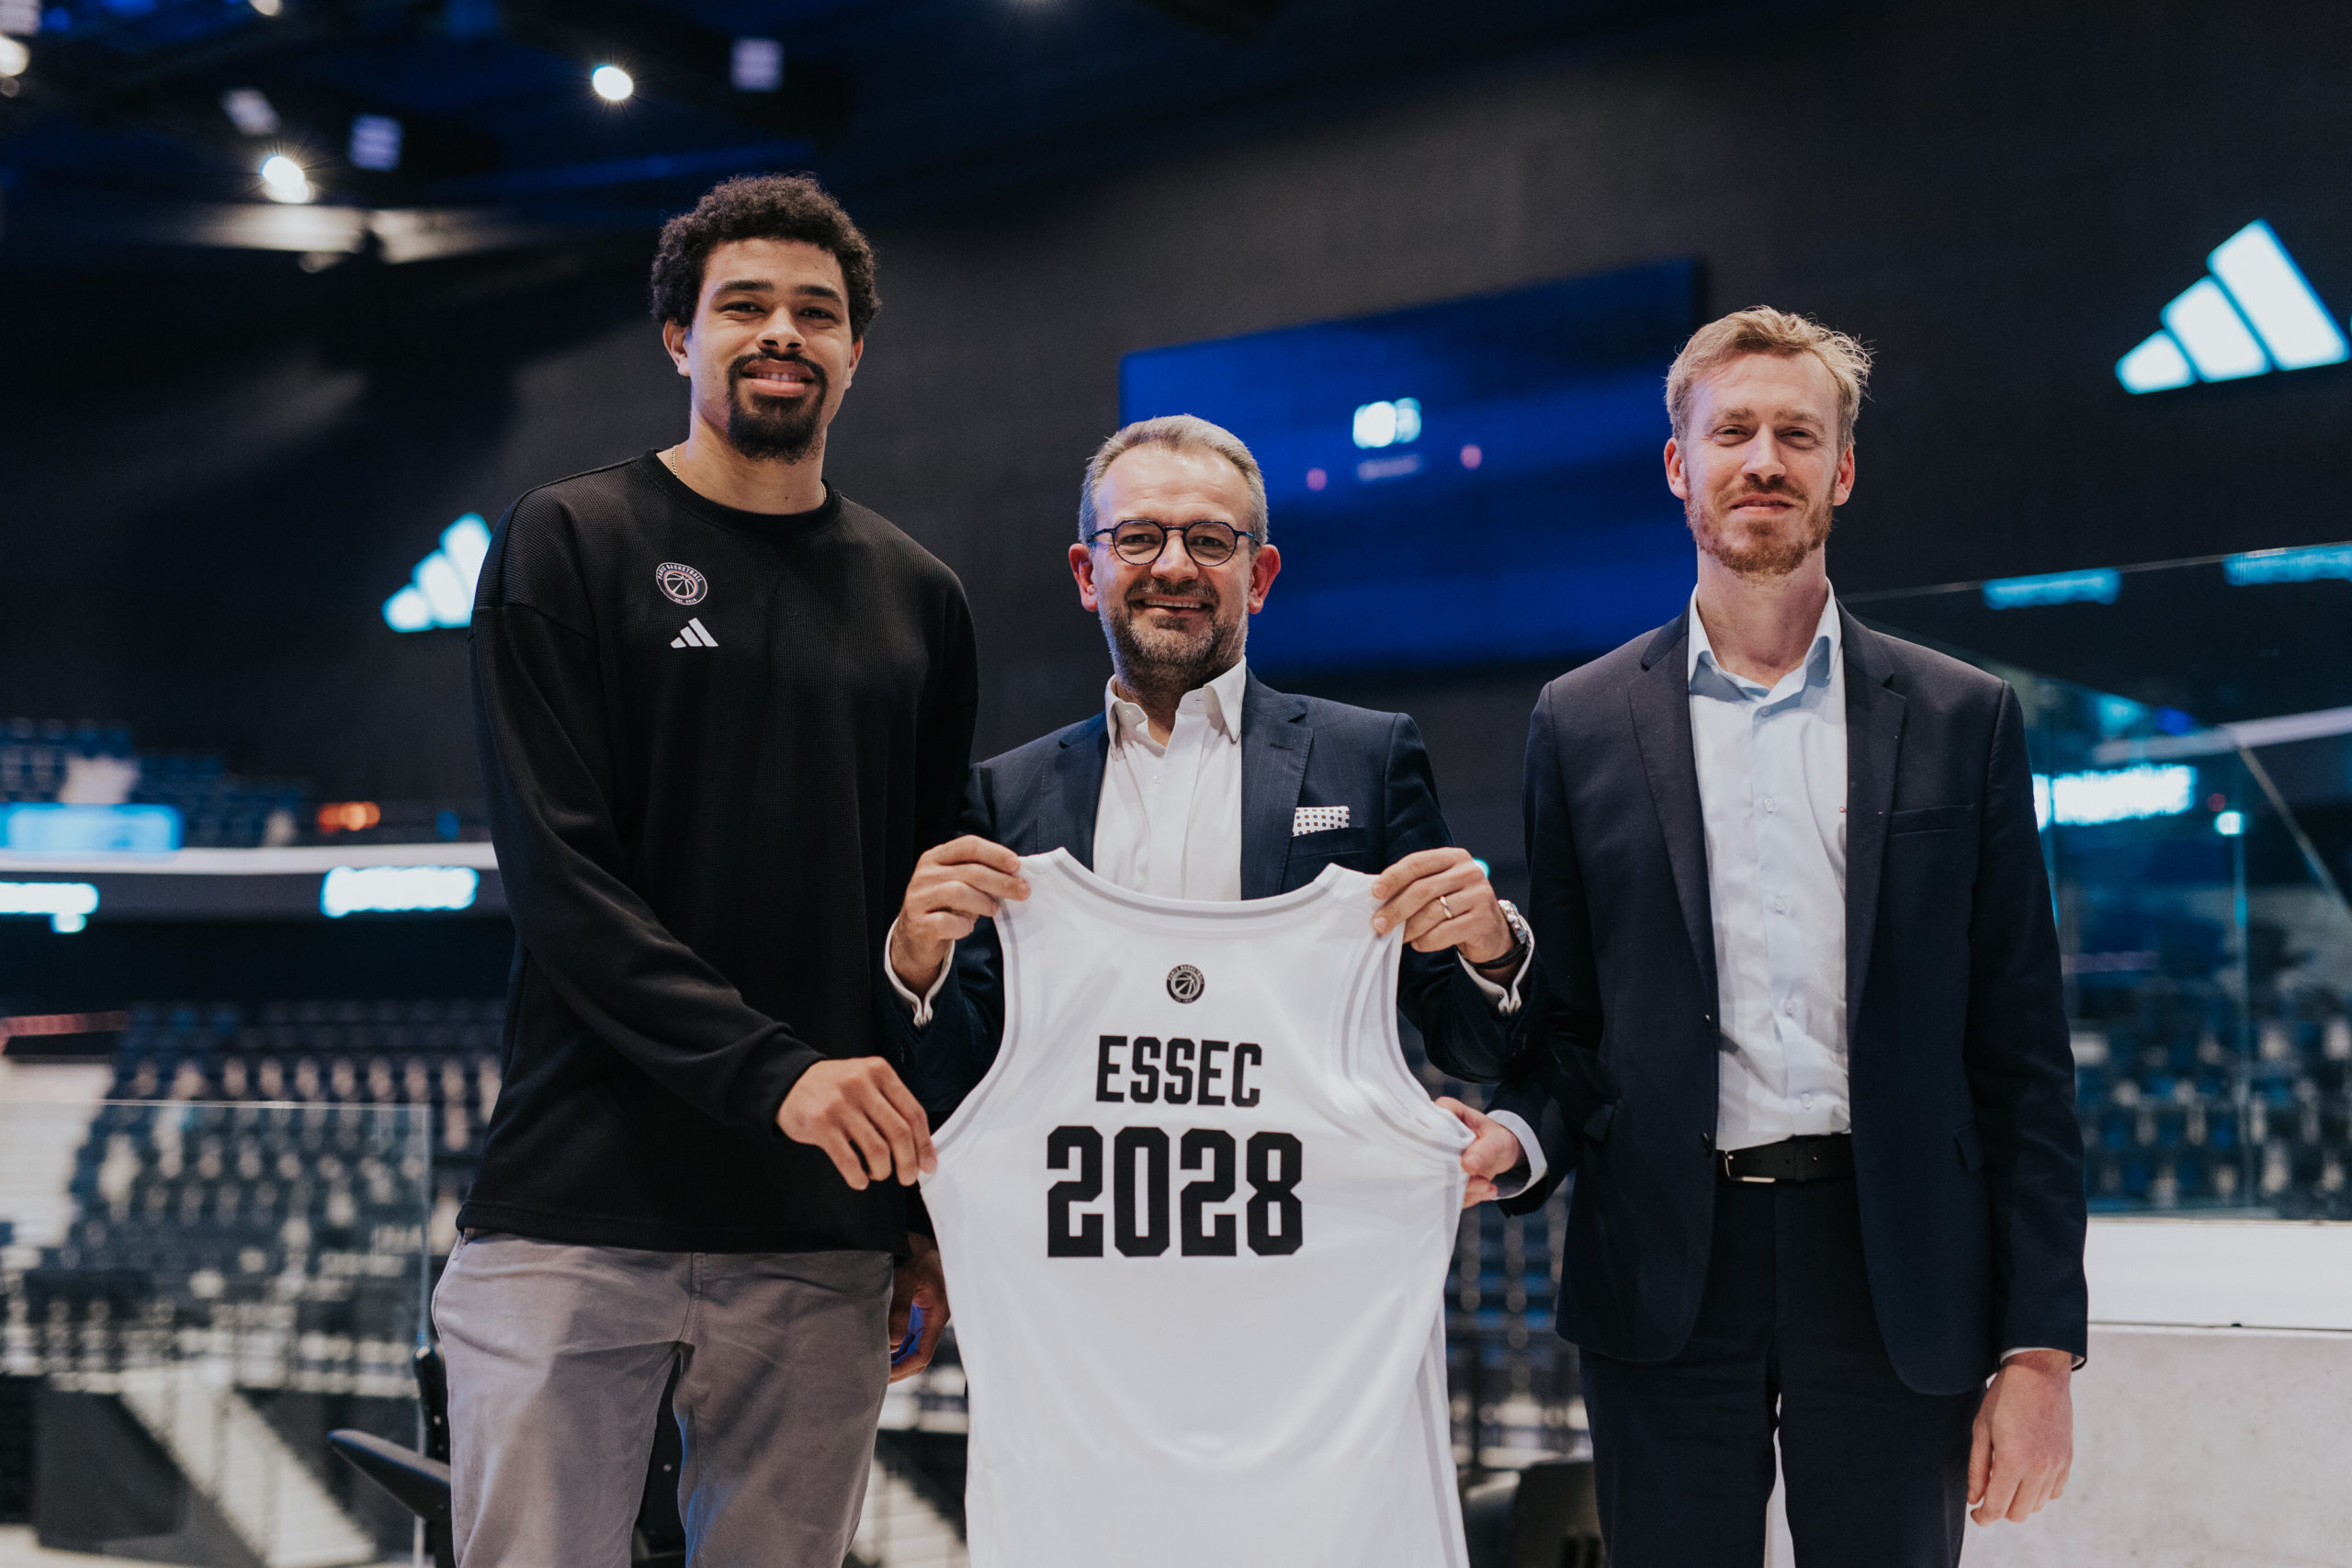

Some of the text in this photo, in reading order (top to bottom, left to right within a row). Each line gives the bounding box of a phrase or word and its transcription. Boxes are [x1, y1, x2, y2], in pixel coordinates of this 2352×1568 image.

[666, 564, 703, 582] BASKETBALL
[1096, 1035, 1261, 1107] ESSEC
[1047, 1126, 1303, 1258] 2028
